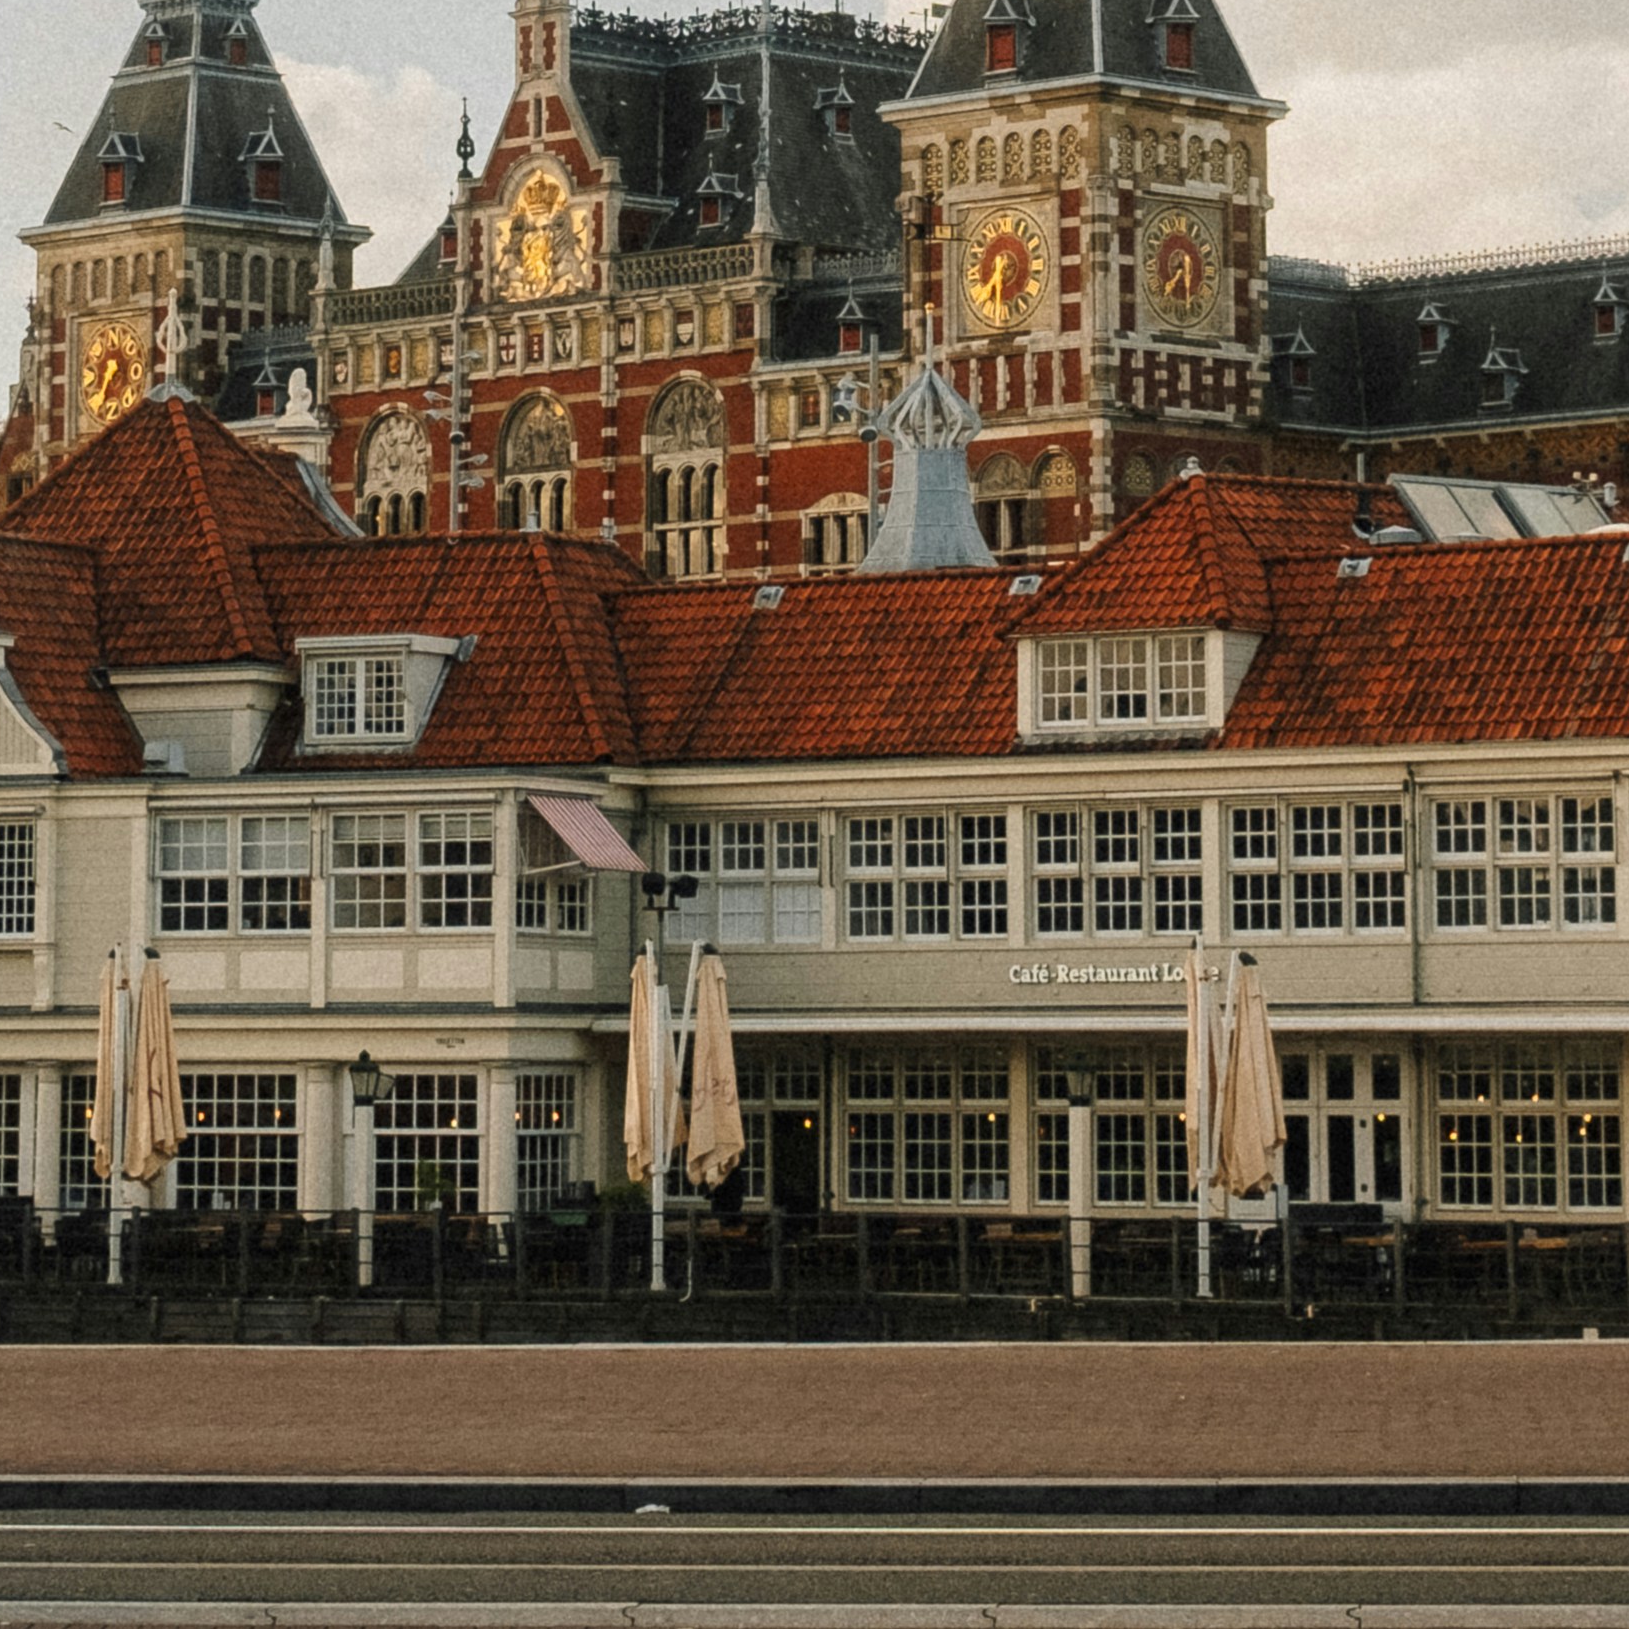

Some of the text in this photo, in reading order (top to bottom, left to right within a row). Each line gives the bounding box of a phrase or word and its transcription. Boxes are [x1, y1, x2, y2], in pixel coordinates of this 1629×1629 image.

[997, 216, 1012, 233] XII
[1017, 220, 1027, 237] I
[106, 328, 120, 347] N
[130, 362, 143, 381] O
[1009, 963, 1220, 984] Café-Restaurant Loe
